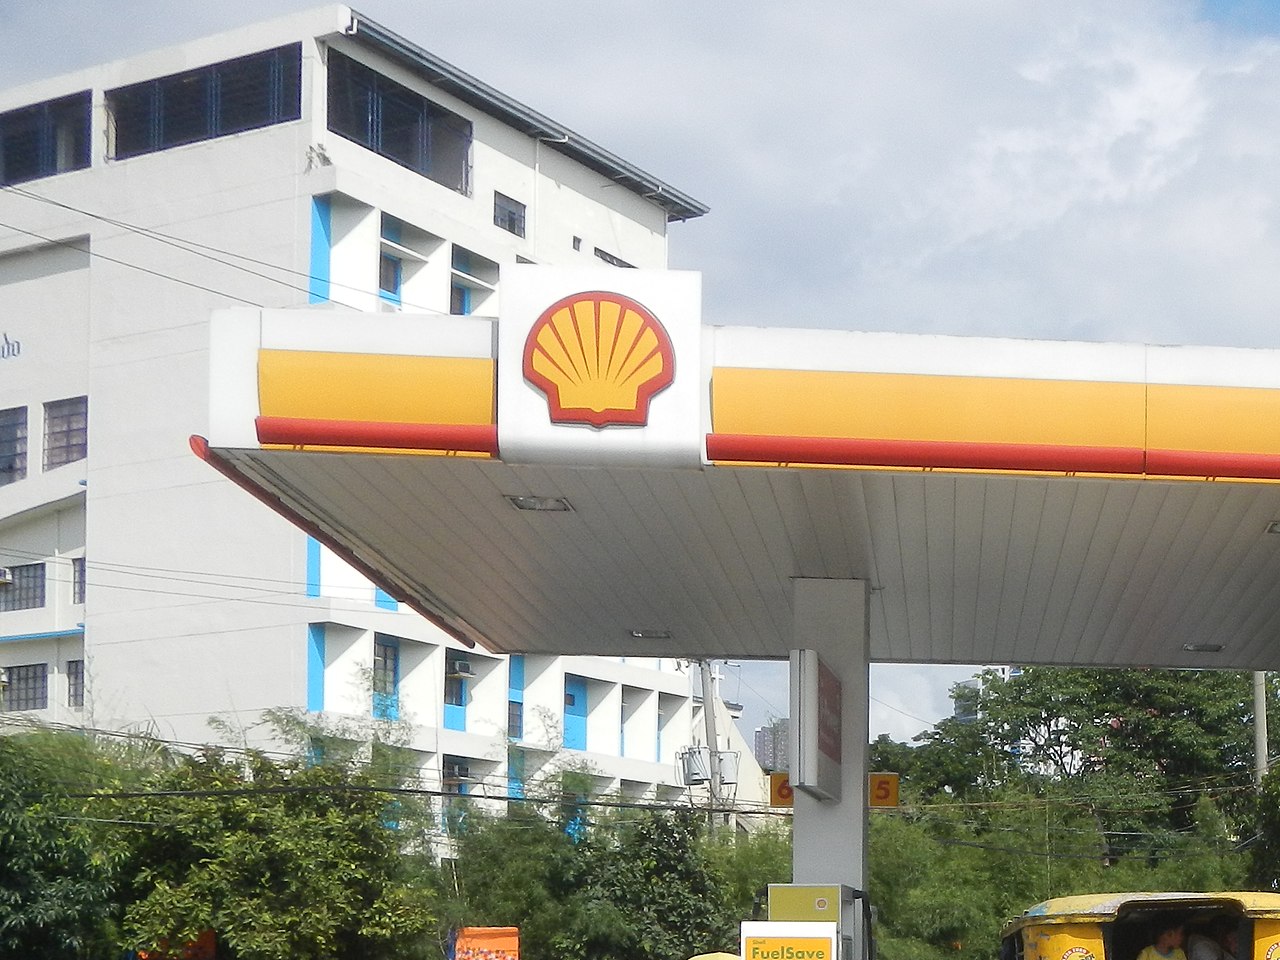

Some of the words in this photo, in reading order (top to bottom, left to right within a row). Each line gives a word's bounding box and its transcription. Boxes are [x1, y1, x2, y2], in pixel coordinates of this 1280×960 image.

[777, 780, 794, 800] 6
[876, 781, 890, 800] 5
[752, 946, 825, 959] FuelSave
